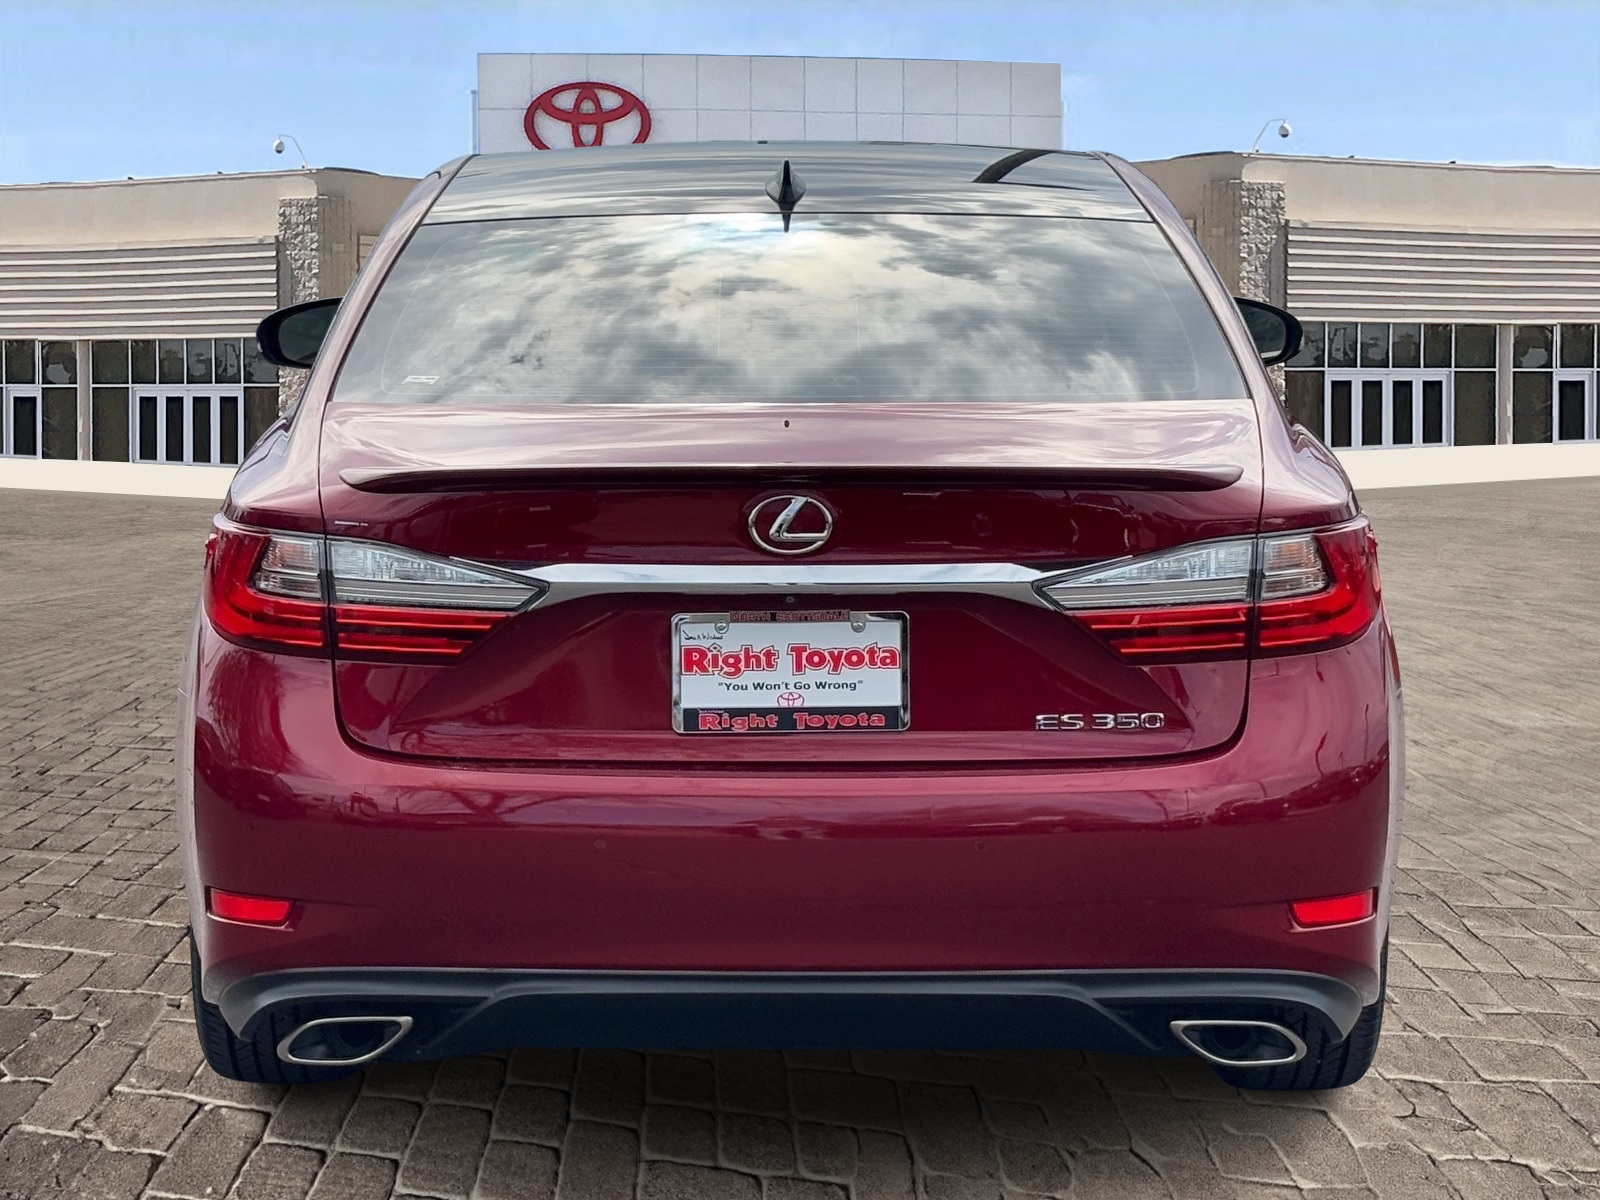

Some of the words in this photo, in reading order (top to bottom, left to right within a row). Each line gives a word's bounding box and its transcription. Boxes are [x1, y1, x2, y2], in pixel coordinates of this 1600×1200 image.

[681, 643, 779, 679] Right
[787, 642, 900, 676] Toyota
[794, 681, 811, 691] Go
[698, 712, 778, 731] Right
[794, 711, 886, 730] Toyota
[1035, 713, 1085, 730] ES
[1091, 712, 1165, 730] 350
